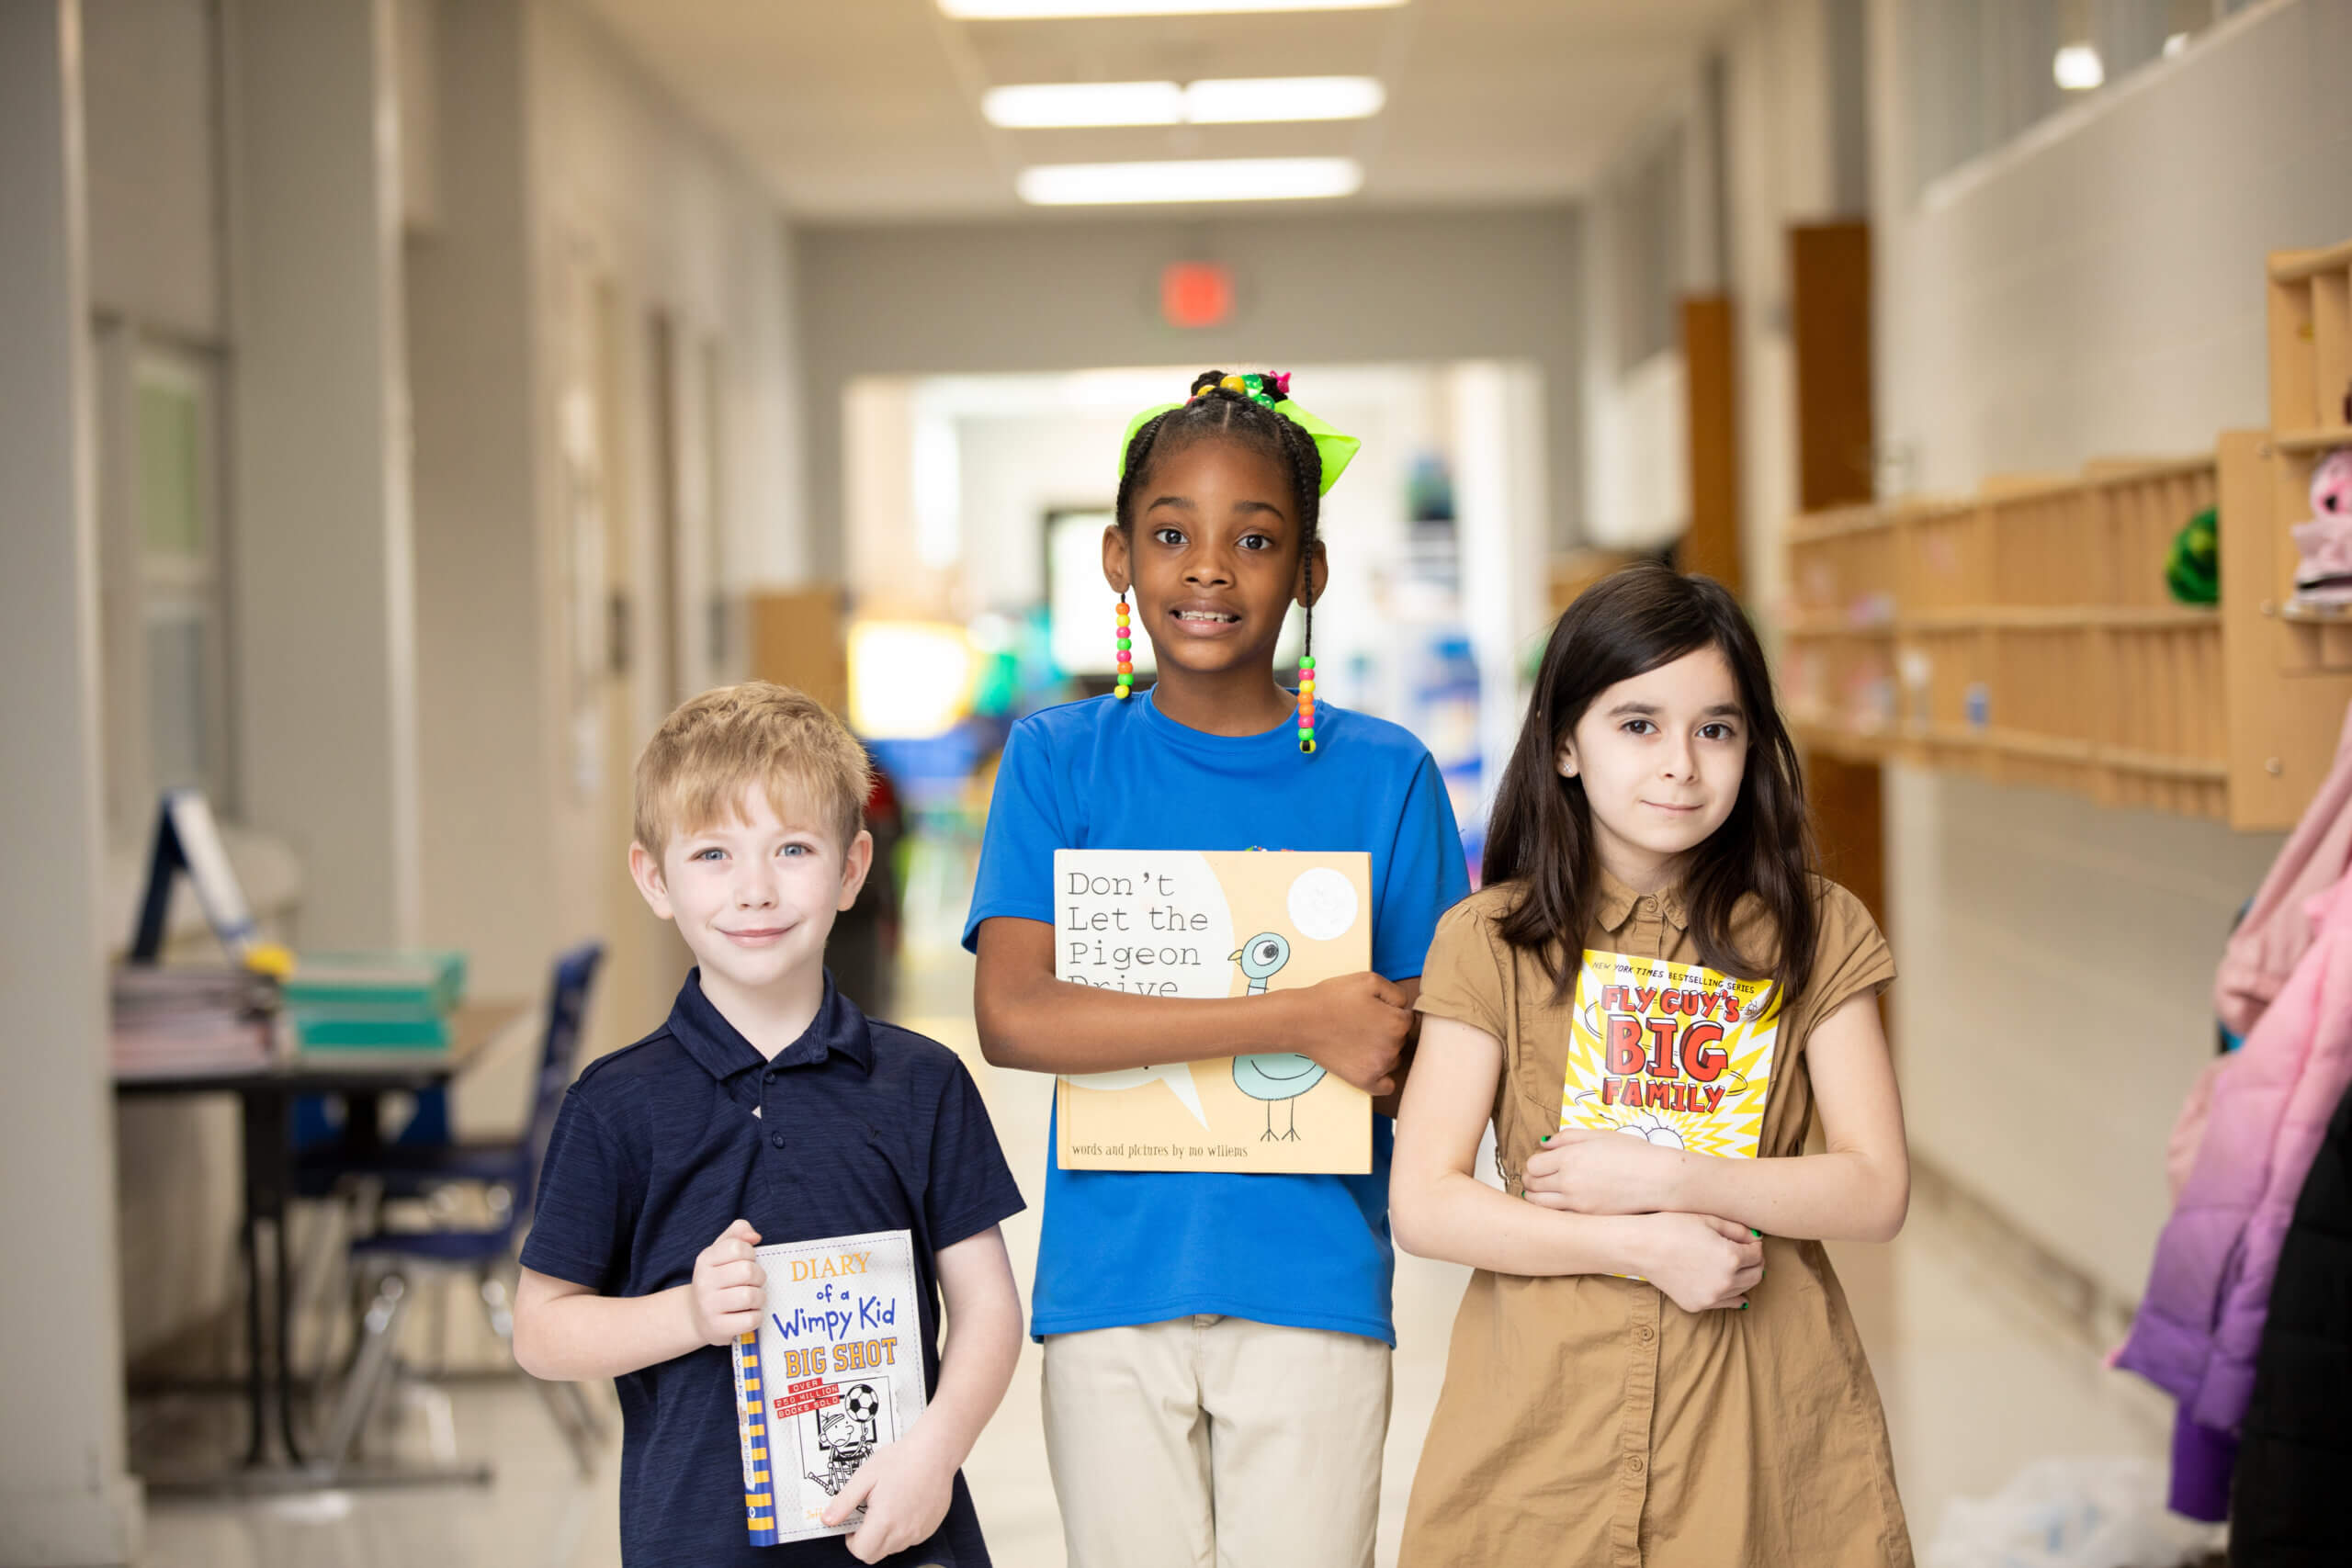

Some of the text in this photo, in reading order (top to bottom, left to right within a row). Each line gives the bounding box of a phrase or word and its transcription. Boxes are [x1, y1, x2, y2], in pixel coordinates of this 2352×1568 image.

[1068, 872, 1175, 897] Don't
[1068, 906, 1208, 931] Let the
[1069, 940, 1202, 971] Pigeon
[1592, 961, 1755, 994] NEW YORK TIMES BESTSELLING SERIES
[1601, 985, 1740, 1022] FLY GUY'S
[1605, 1014, 1729, 1082] BIG
[1601, 1077, 1725, 1114] FAMILY
[1072, 1143, 1250, 1159] words and pictures by mo willems
[790, 1251, 872, 1281] DIARY
[816, 1283, 850, 1303] of a
[772, 1295, 896, 1342] Wimpy Kid
[784, 1337, 898, 1379] BIG SHOT
[776, 1386, 838, 1407] 250 MILLION
[793, 1380, 819, 1392] OVER
[778, 1397, 838, 1417] BOOKS SOLD
